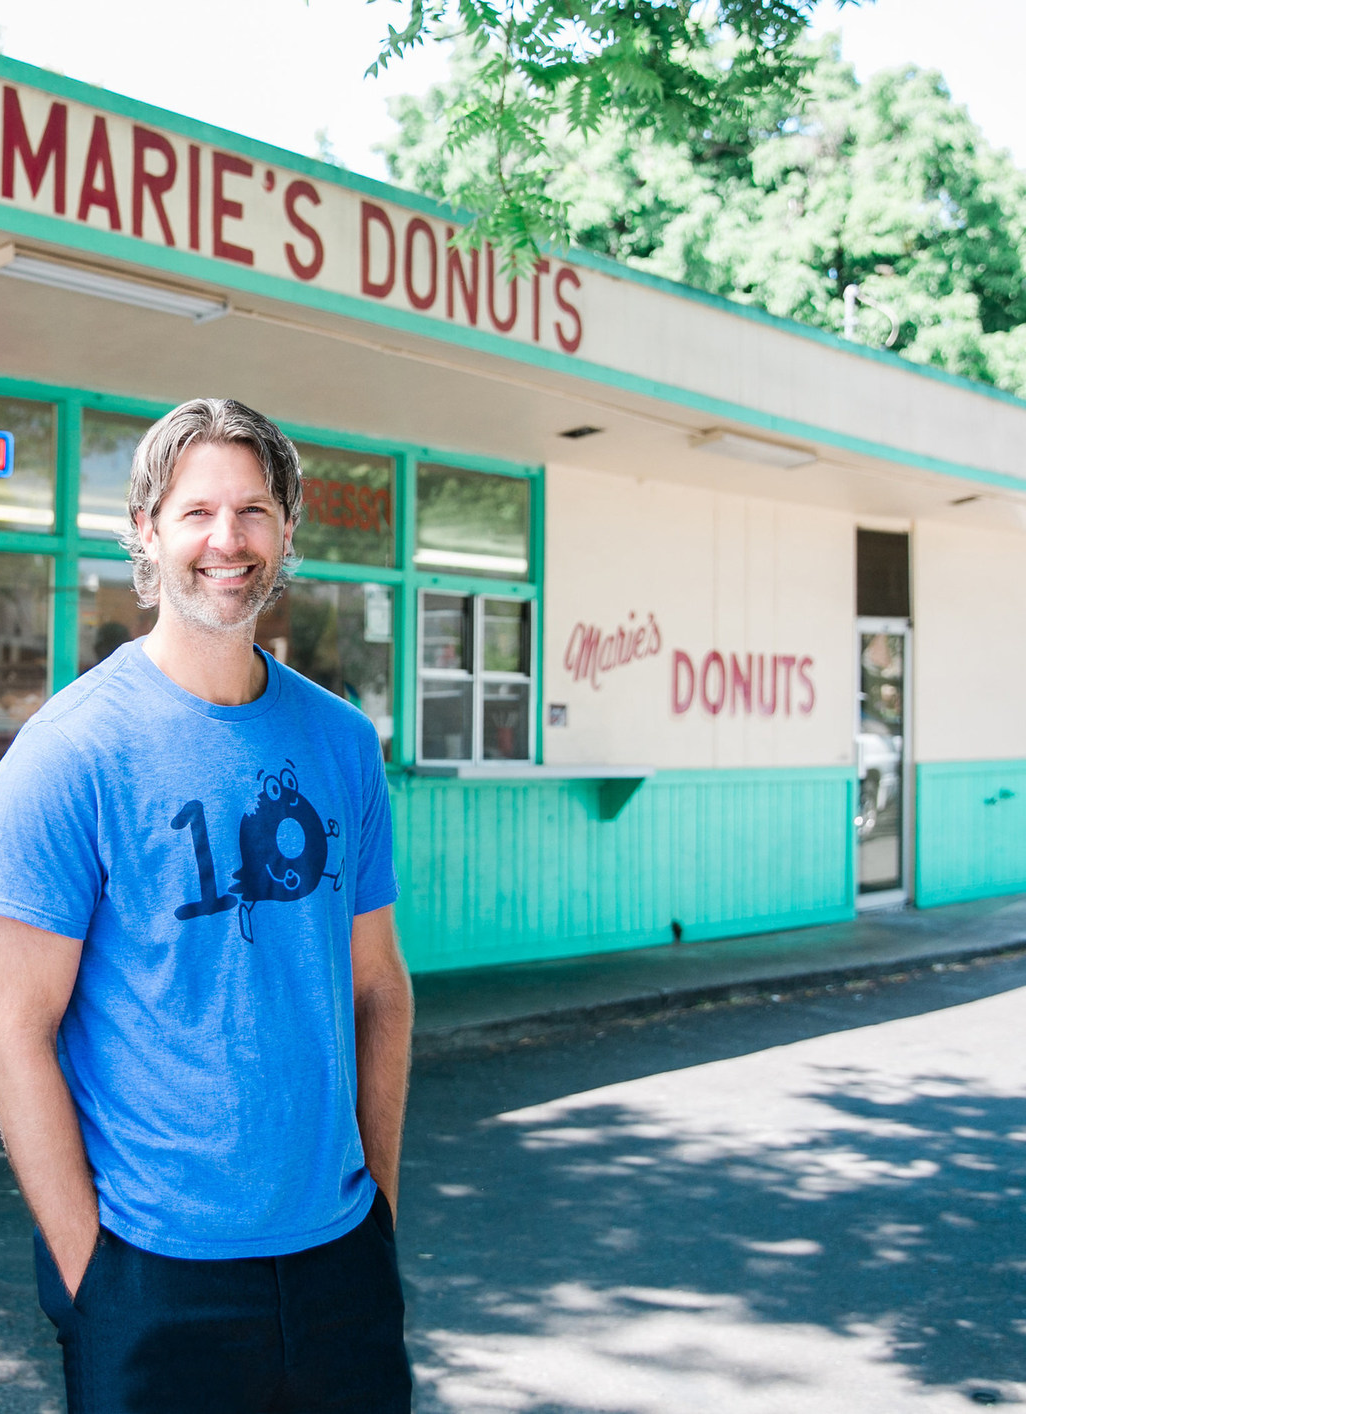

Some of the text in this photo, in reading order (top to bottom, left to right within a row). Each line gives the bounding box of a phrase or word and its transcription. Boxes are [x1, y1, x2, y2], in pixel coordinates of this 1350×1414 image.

[1, 85, 582, 354] MARIE'S DONUTS
[563, 611, 815, 718] Marie's DONUTS
